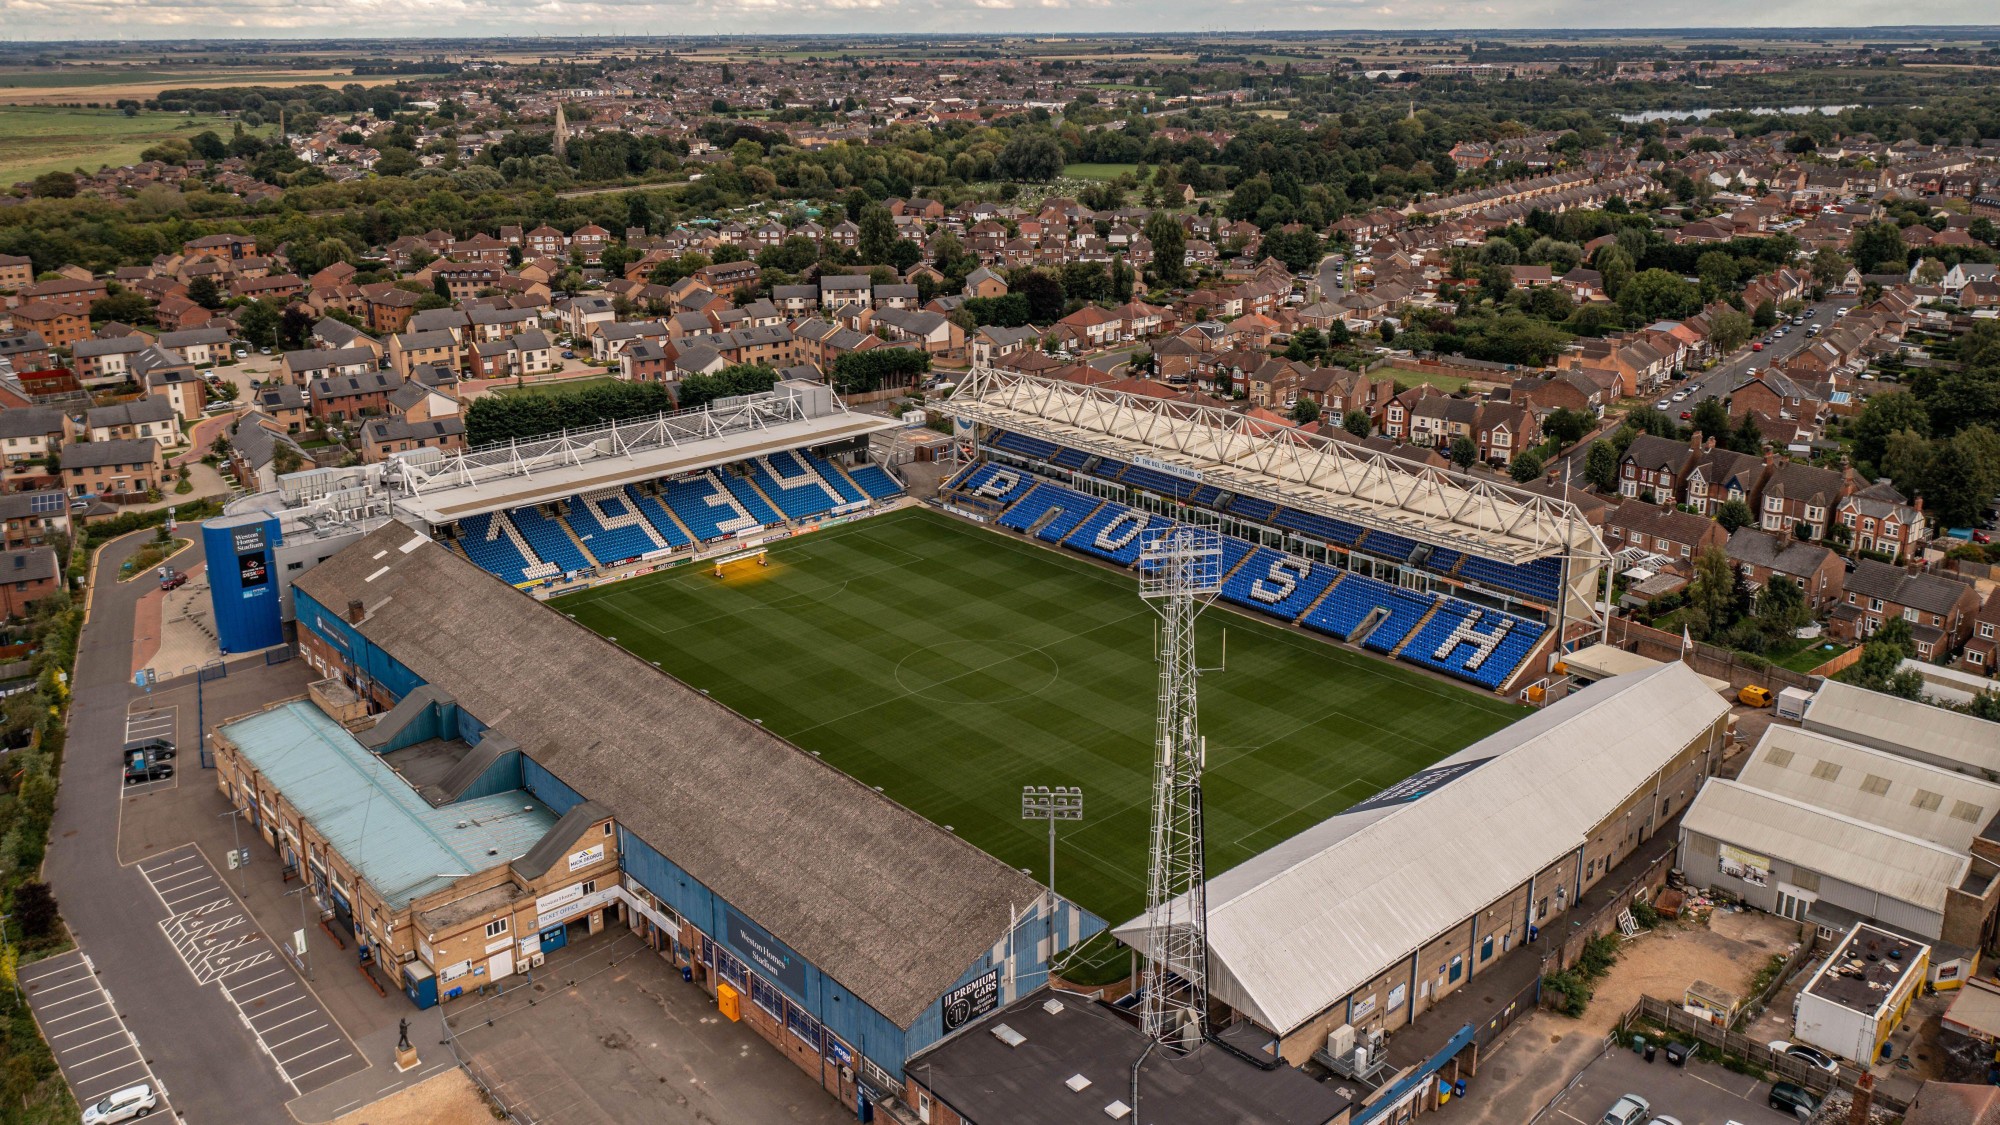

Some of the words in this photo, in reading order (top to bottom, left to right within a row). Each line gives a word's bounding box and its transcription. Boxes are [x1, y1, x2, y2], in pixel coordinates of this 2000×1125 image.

[1162, 463, 1179, 472] FAMILY
[235, 532, 258, 540] Weston
[236, 537, 259, 546] Homes
[237, 542, 264, 551] Stadium
[540, 911, 560, 922] TICKET
[560, 903, 579, 915] OFFICE
[740, 929, 763, 953] Weston
[763, 946, 786, 969] Homes
[752, 950, 778, 976] Stadium
[953, 970, 997, 1000] PREMIUM
[974, 980, 997, 999] CARS
